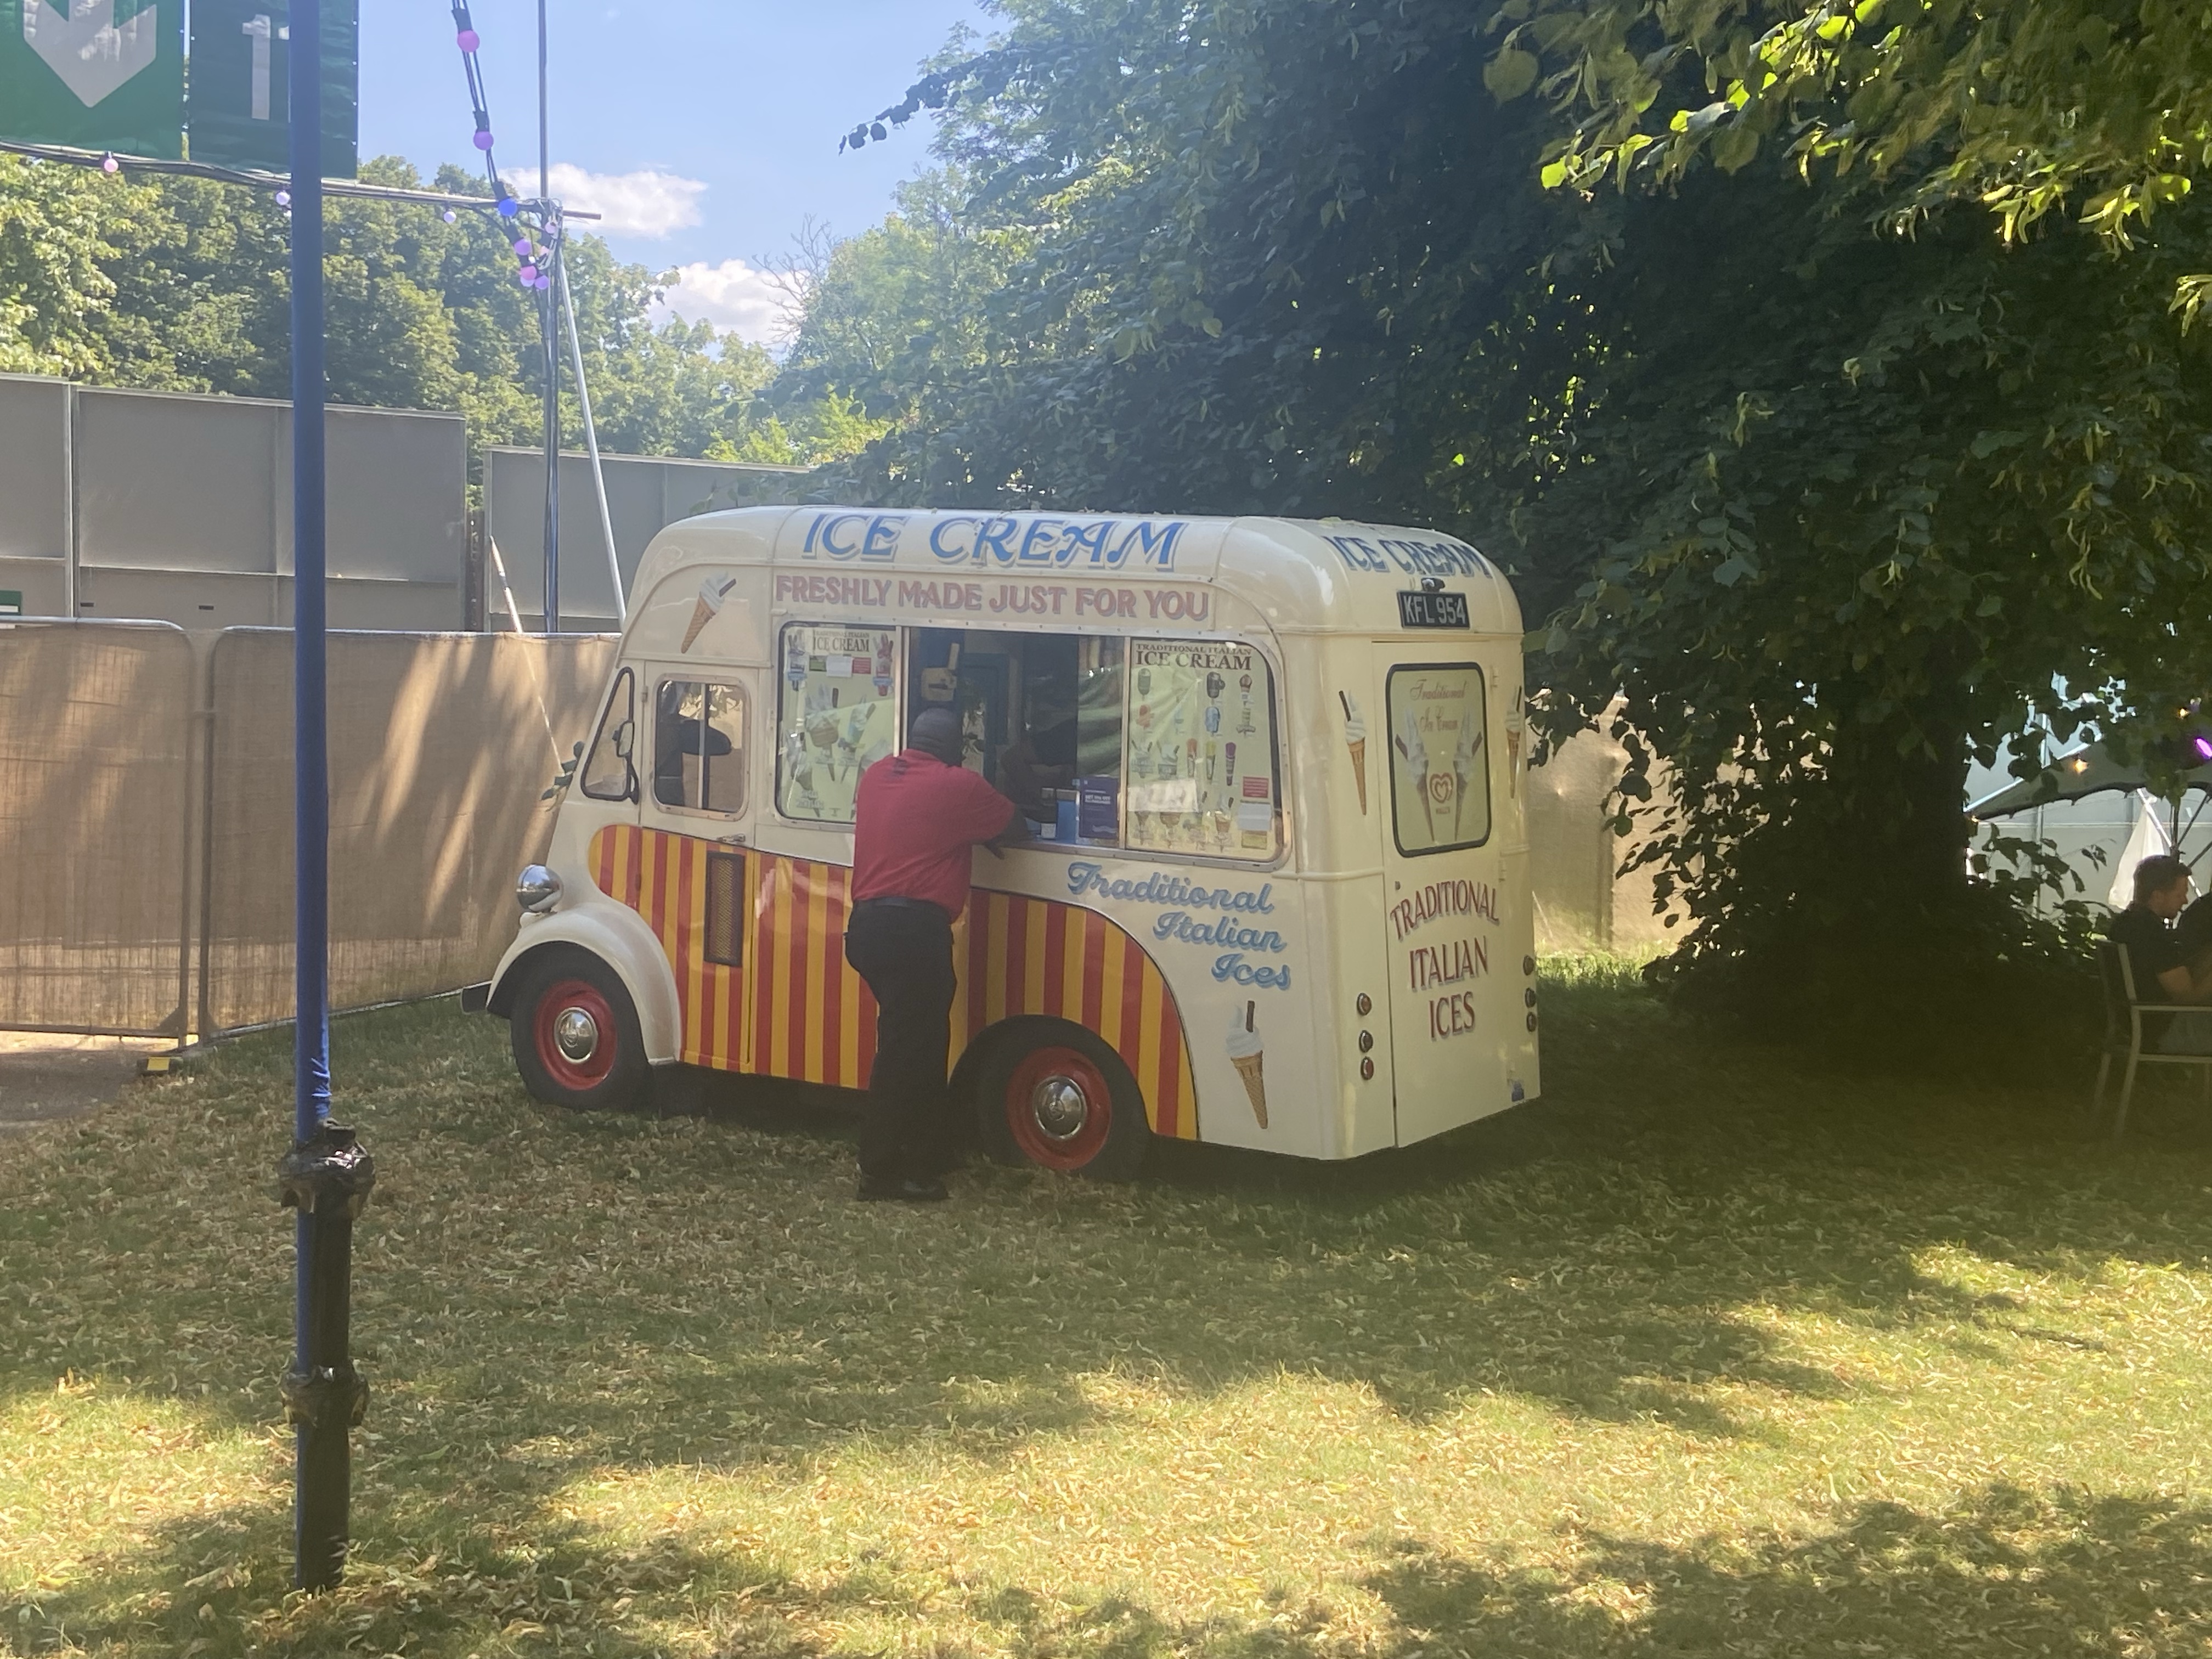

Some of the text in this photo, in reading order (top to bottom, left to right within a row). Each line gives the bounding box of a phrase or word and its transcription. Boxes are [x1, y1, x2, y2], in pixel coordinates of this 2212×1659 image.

[802, 514, 1189, 572] ICE CREAM
[1321, 535, 1493, 579] ICE CREAM
[776, 575, 1208, 621] FRESHLY MADE JUST FOR YOU
[1403, 595, 1466, 624] KFL 954
[813, 636, 870, 652] ICE CREAM
[1136, 644, 1252, 655] TRADITIONAL ITALIAN
[1136, 651, 1252, 670] ICE CREAM
[1409, 679, 1468, 701] Traditional
[1067, 861, 1274, 915] Traditional
[1153, 911, 1287, 953] Italian
[1390, 879, 1500, 943] TRADITIONAL
[1211, 953, 1291, 990] Ices
[1409, 935, 1488, 993] ITALIAN
[1429, 991, 1476, 1042] ICES
